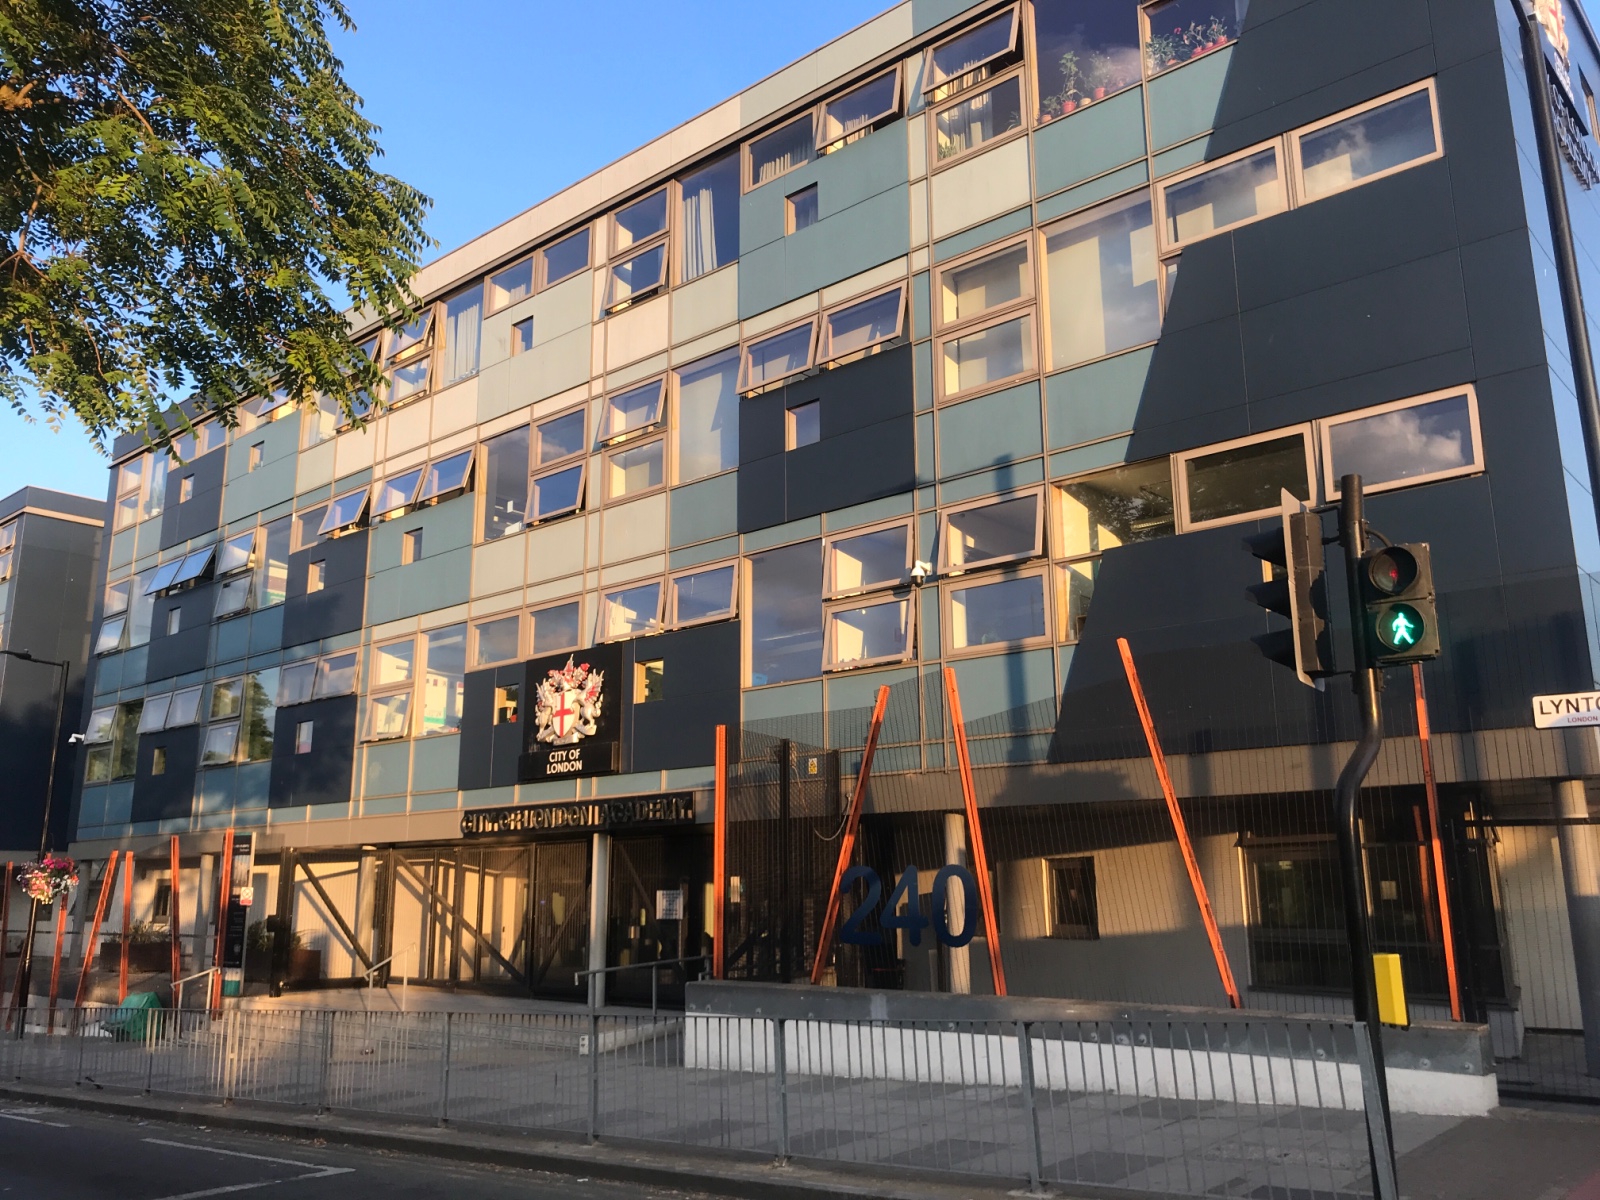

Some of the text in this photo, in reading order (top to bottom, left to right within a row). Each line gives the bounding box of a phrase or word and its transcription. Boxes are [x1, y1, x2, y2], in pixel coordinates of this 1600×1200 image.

[549, 749, 580, 762] CITY OF
[546, 760, 582, 774] LONDON
[523, 805, 593, 829] LONDON
[839, 864, 977, 948] 240
